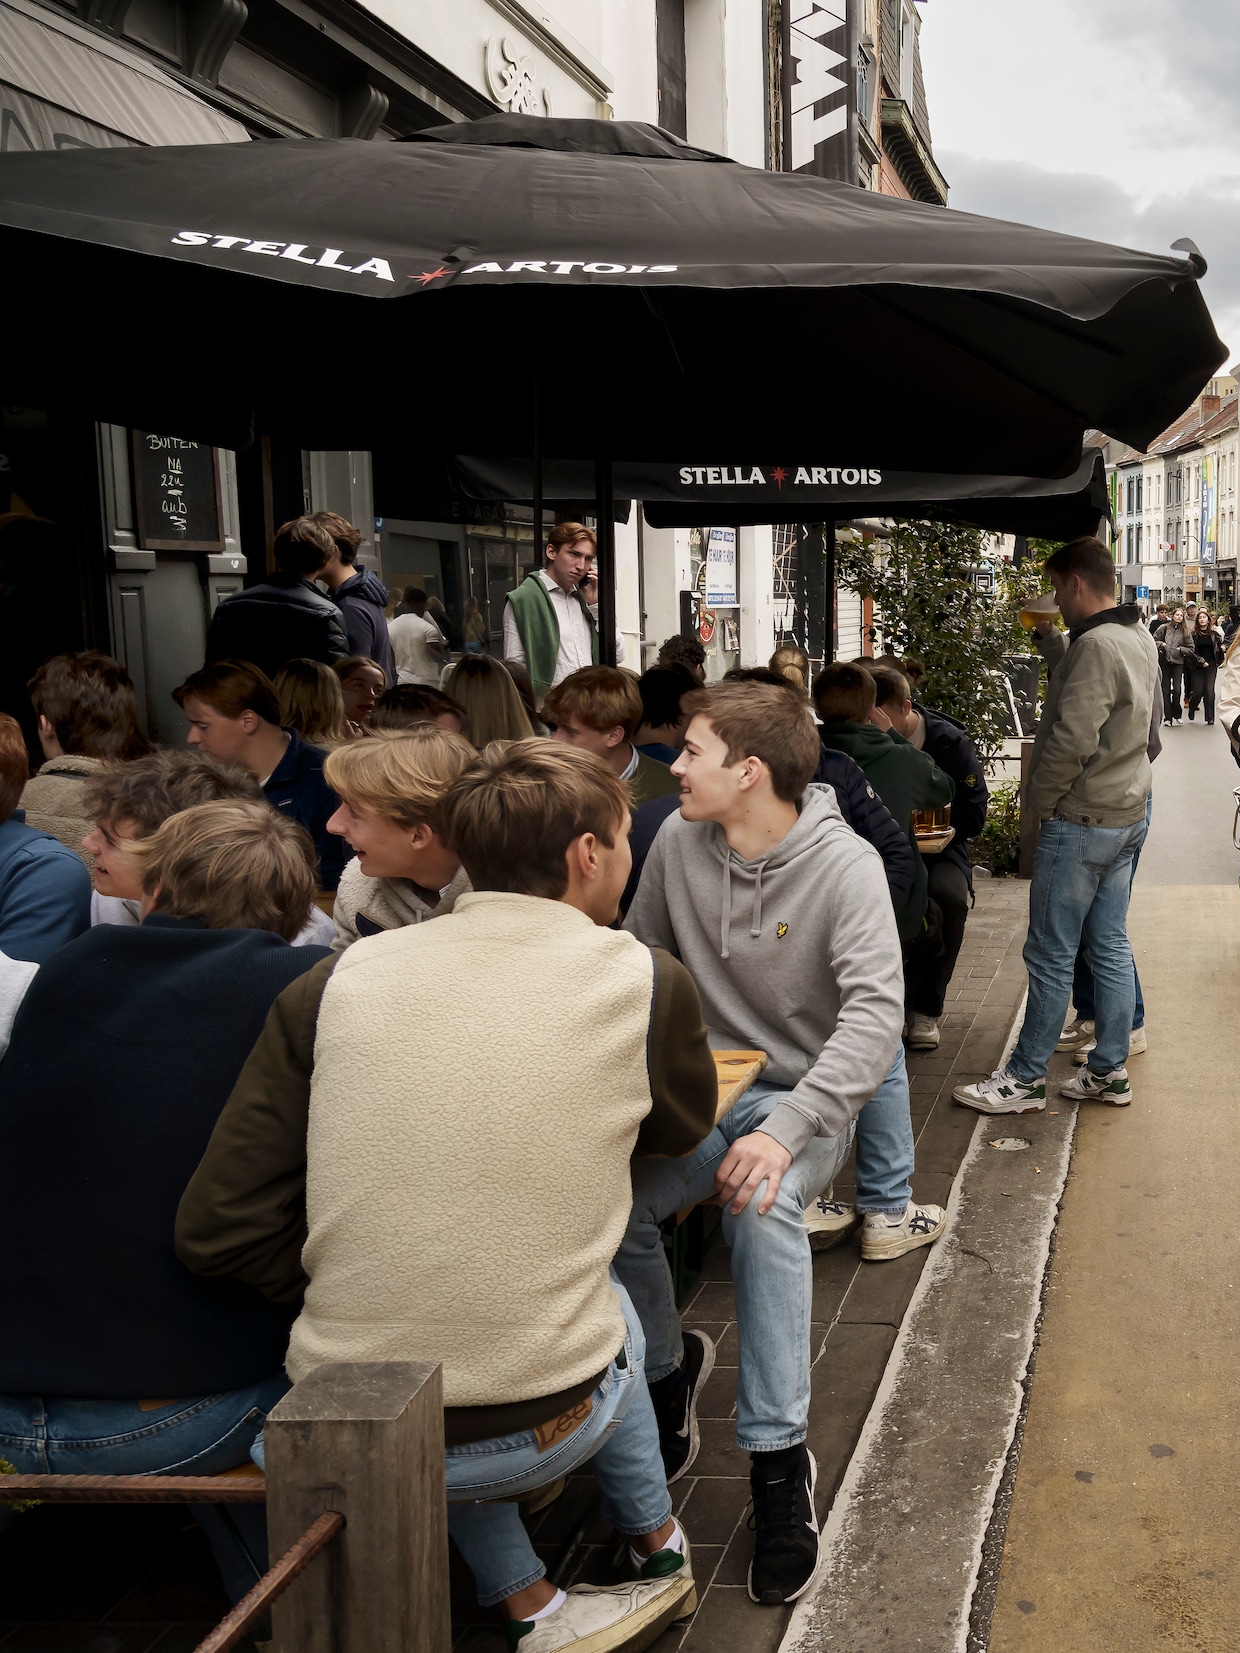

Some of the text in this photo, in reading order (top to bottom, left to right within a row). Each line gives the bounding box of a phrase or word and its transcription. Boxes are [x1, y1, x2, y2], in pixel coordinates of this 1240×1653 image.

[171, 231, 679, 282] STELLA ARTOIS
[146, 434, 199, 451] BUITEN
[167, 457, 182, 471] NA
[679, 466, 882, 485] STELLA ARTOIS
[162, 496, 188, 515] aub
[536, 1401, 589, 1448] Lee
